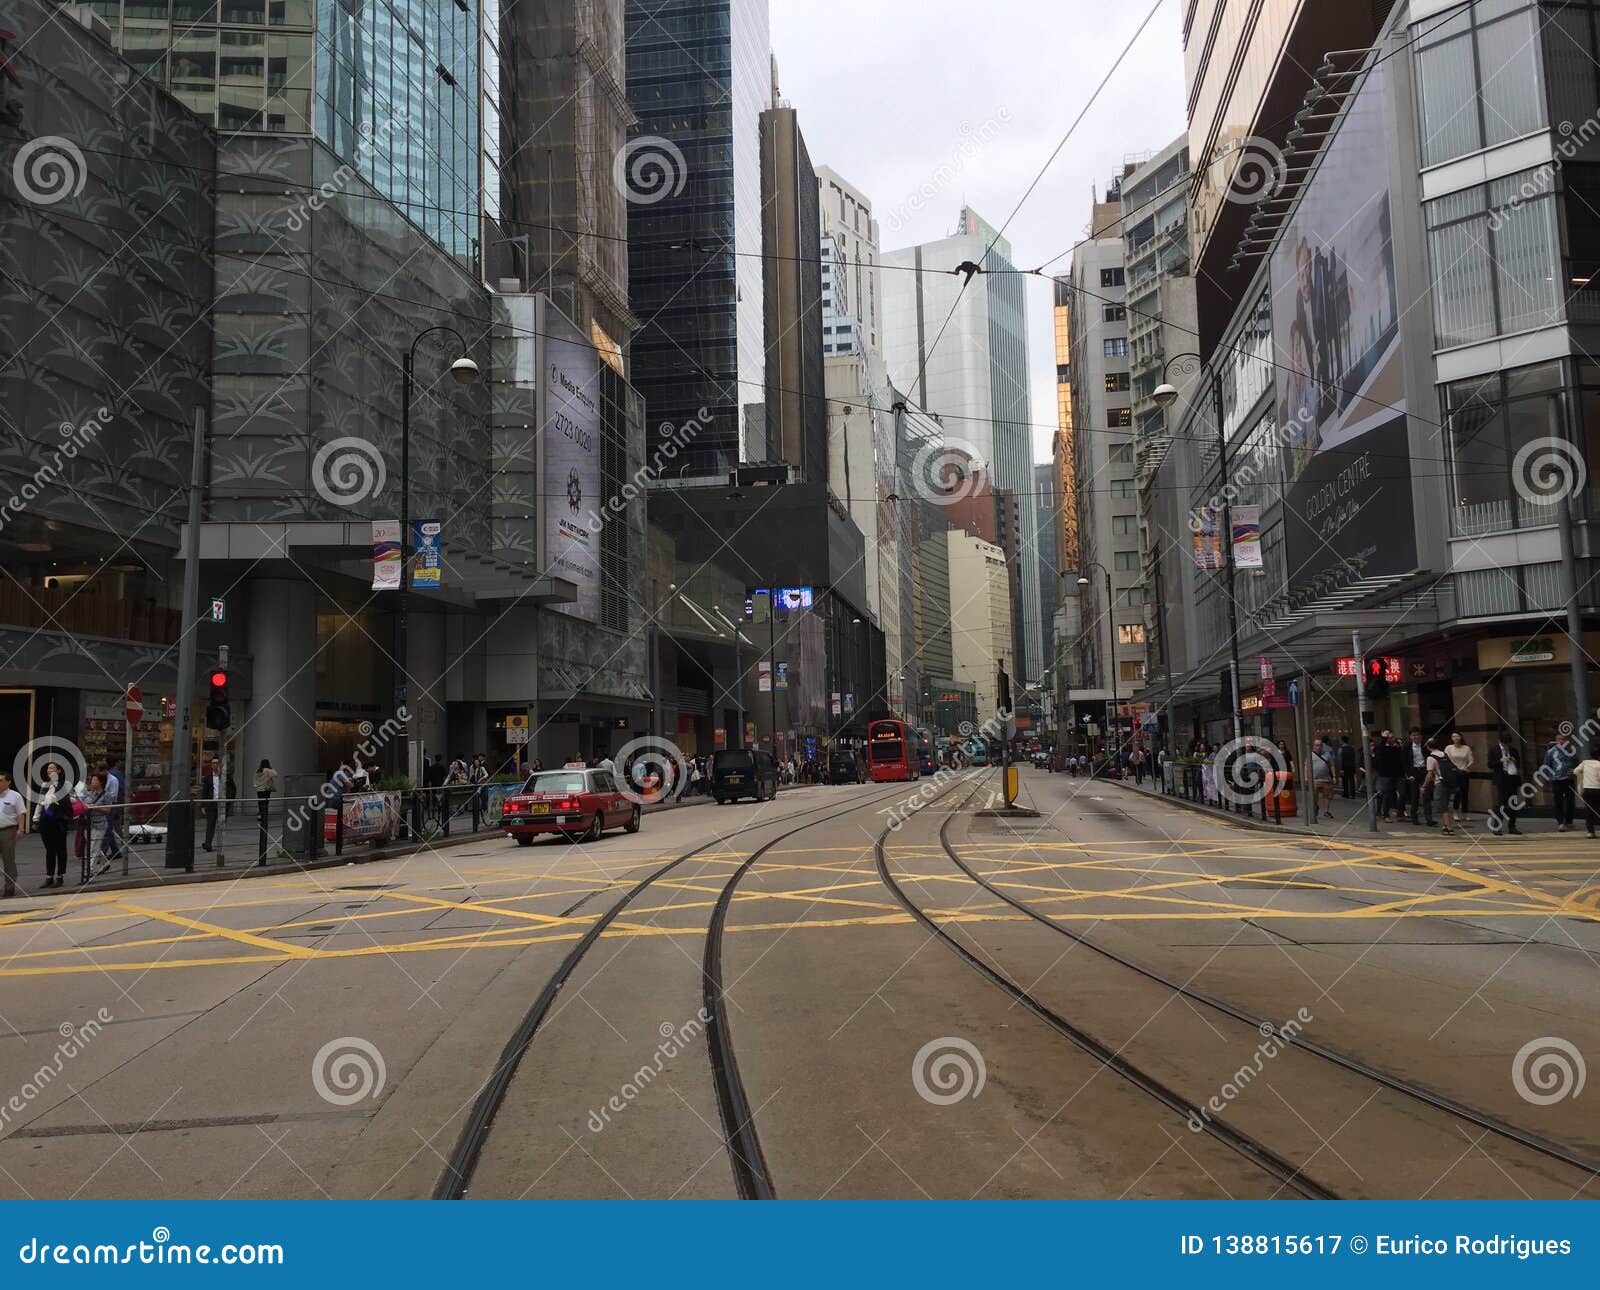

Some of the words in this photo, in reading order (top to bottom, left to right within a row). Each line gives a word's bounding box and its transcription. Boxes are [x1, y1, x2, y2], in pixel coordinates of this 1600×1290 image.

[555, 410, 573, 440] 2723
[575, 426, 592, 453] 0020
[1337, 450, 1372, 497] CENTRE
